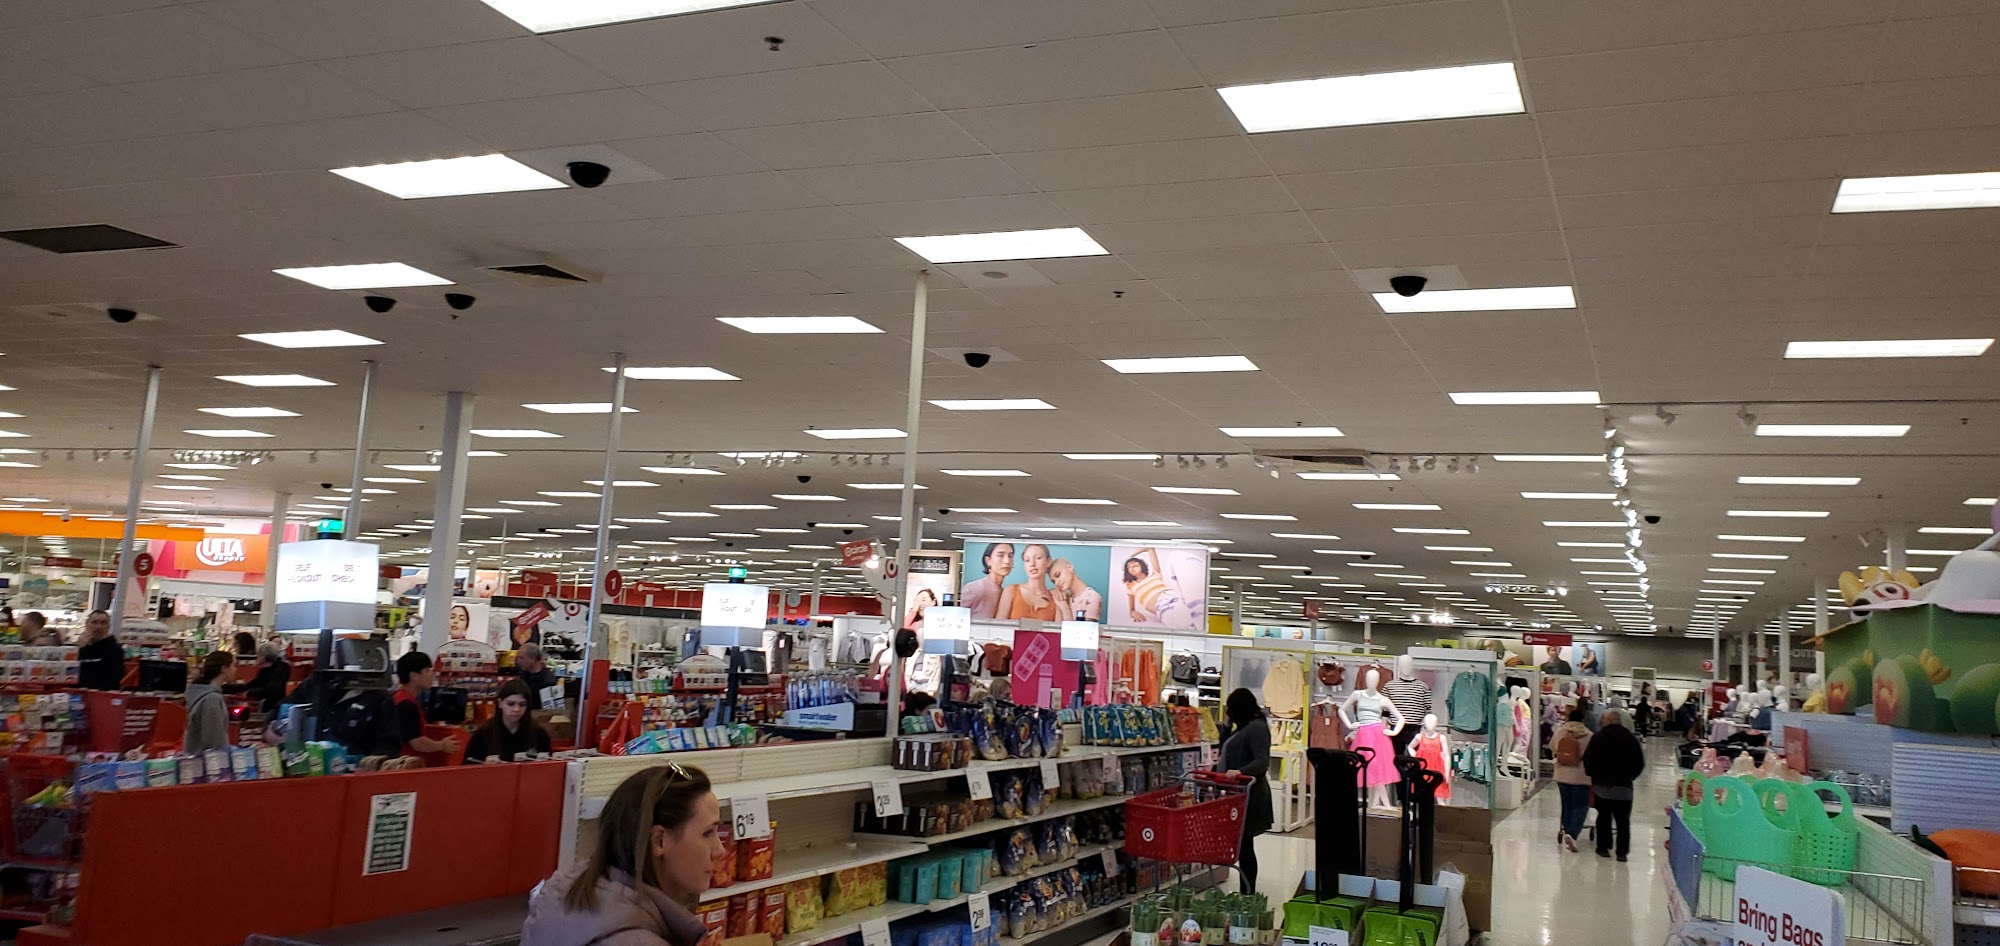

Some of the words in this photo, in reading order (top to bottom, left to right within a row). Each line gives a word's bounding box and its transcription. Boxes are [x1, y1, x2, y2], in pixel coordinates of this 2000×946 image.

[201, 537, 244, 559] ULTA
[139, 559, 149, 571] 5
[610, 577, 617, 590] 1
[1738, 898, 1777, 942] Bring
[1782, 913, 1824, 946] Bags
